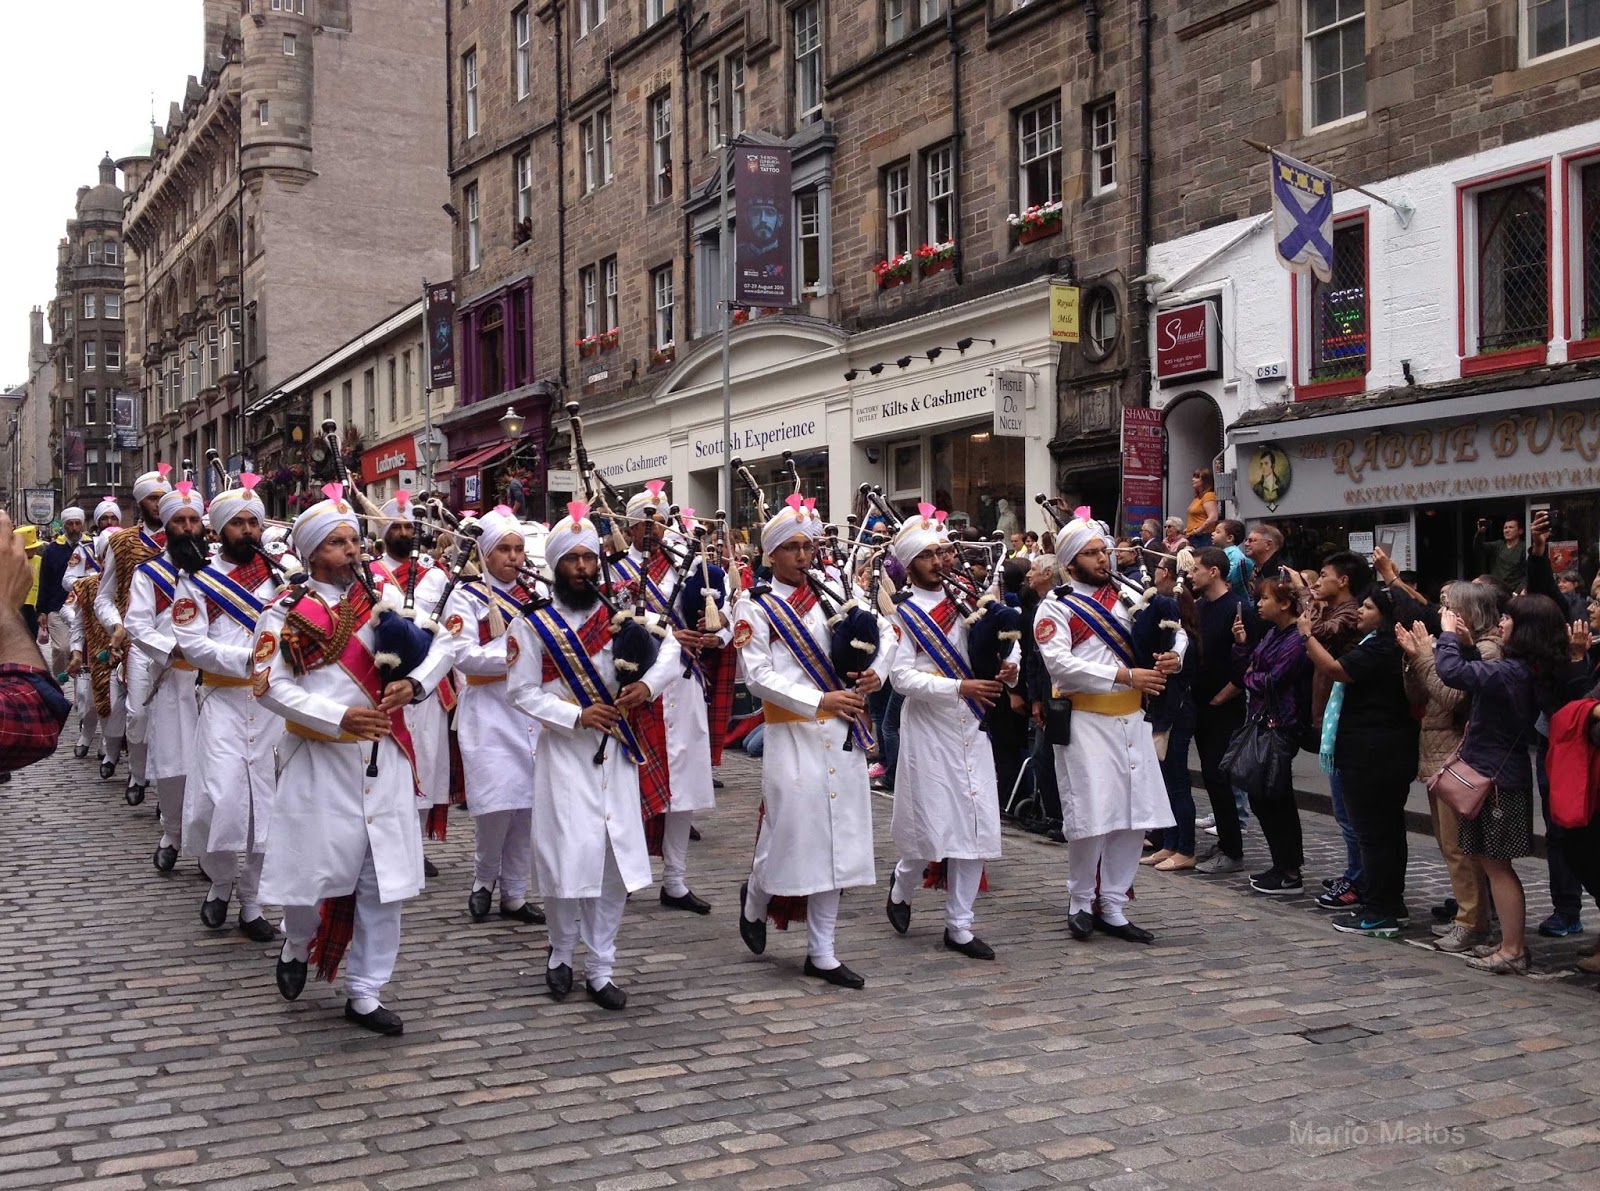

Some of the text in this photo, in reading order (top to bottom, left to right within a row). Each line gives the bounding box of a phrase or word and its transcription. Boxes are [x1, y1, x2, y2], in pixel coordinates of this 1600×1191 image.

[1056, 298, 1075, 309] Royal
[1057, 314, 1073, 323] Mile
[1157, 318, 1205, 352] Shamoli
[998, 377, 1023, 392] THISTLE
[856, 404, 879, 416] FACTORY
[881, 401, 908, 419] Kilts
[911, 397, 921, 412] &
[923, 384, 987, 409] Cashmere
[1003, 395, 1018, 413] Do
[857, 413, 878, 424] OUTLET
[1000, 415, 1022, 430] NICELY
[695, 421, 816, 458] Scottsh Experience
[375, 449, 406, 474] Ladbrokes
[1332, 422, 1480, 483] RABBIE
[625, 454, 668, 473] Cashmere
[1343, 478, 1450, 505] RESTAURANT
[1450, 476, 1489, 496] AND
[1491, 467, 1568, 492] WHISKY
